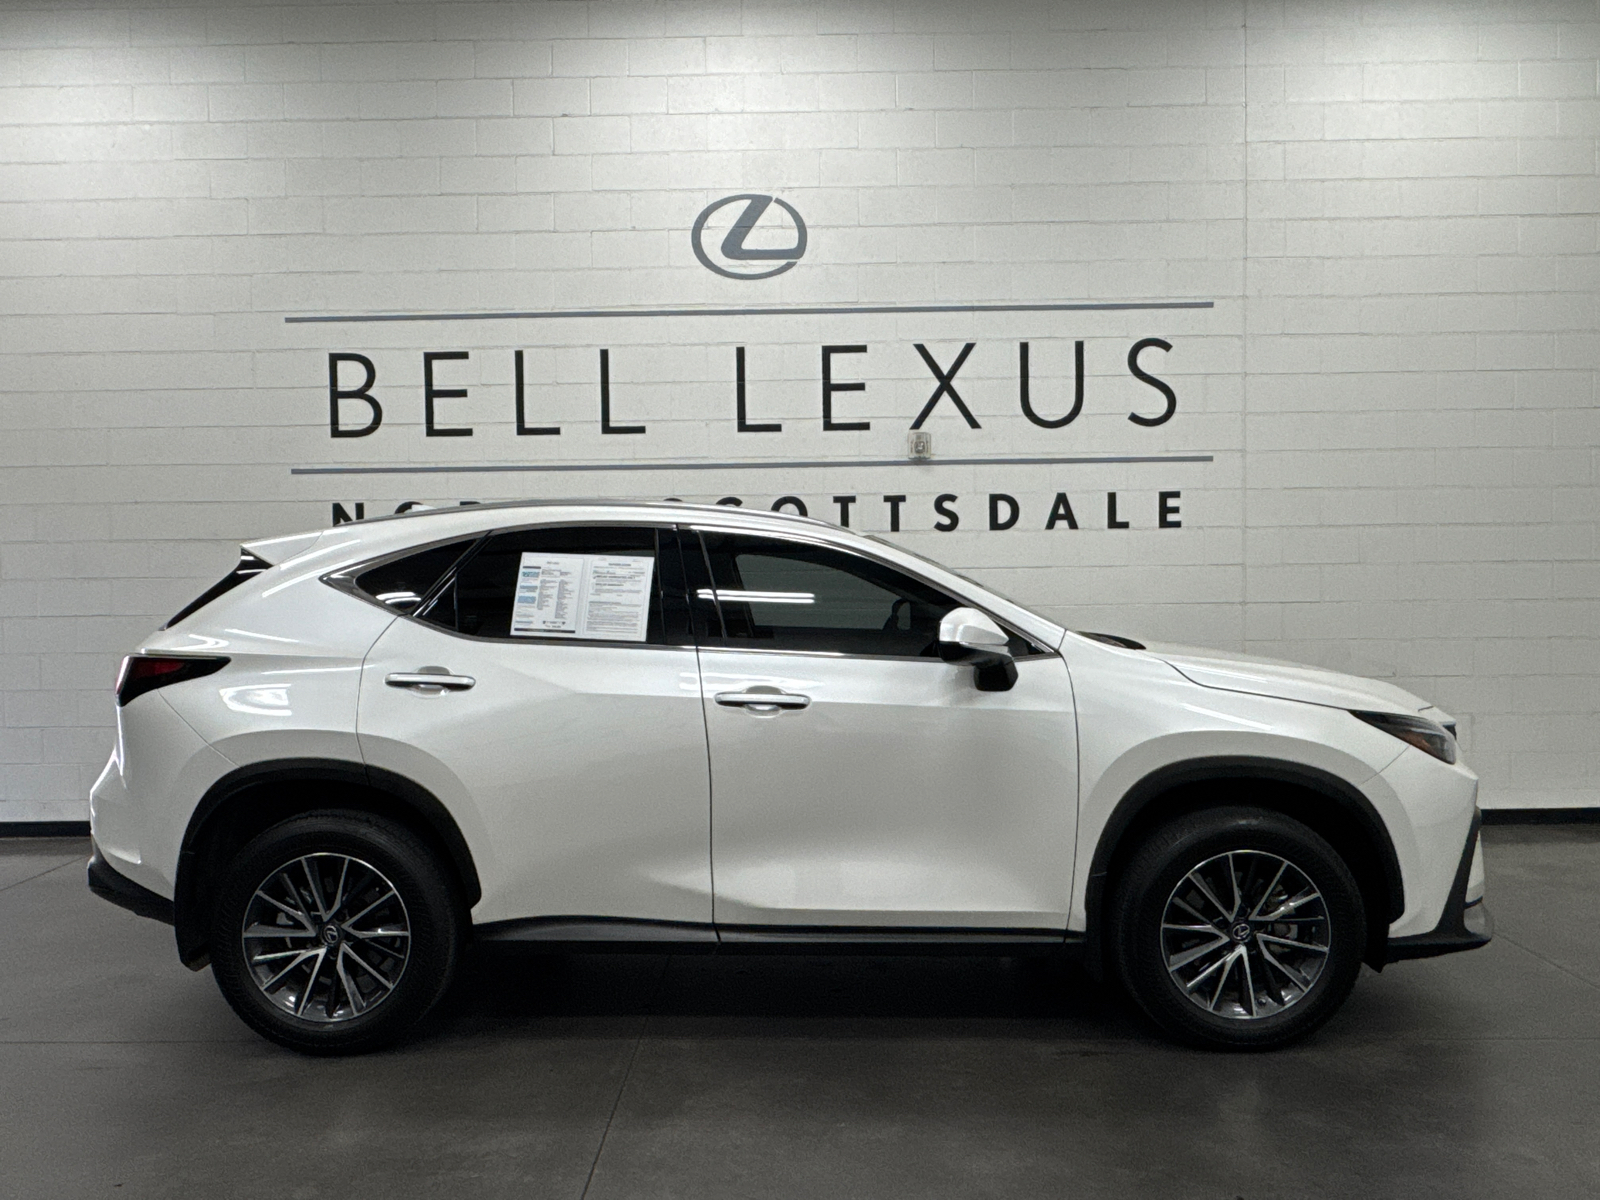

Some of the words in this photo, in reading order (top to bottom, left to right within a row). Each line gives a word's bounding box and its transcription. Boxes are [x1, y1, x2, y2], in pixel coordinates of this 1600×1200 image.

[328, 348, 646, 439] BELL
[736, 337, 1178, 433] LEXUS
[663, 490, 1182, 532] OTTSDALE
